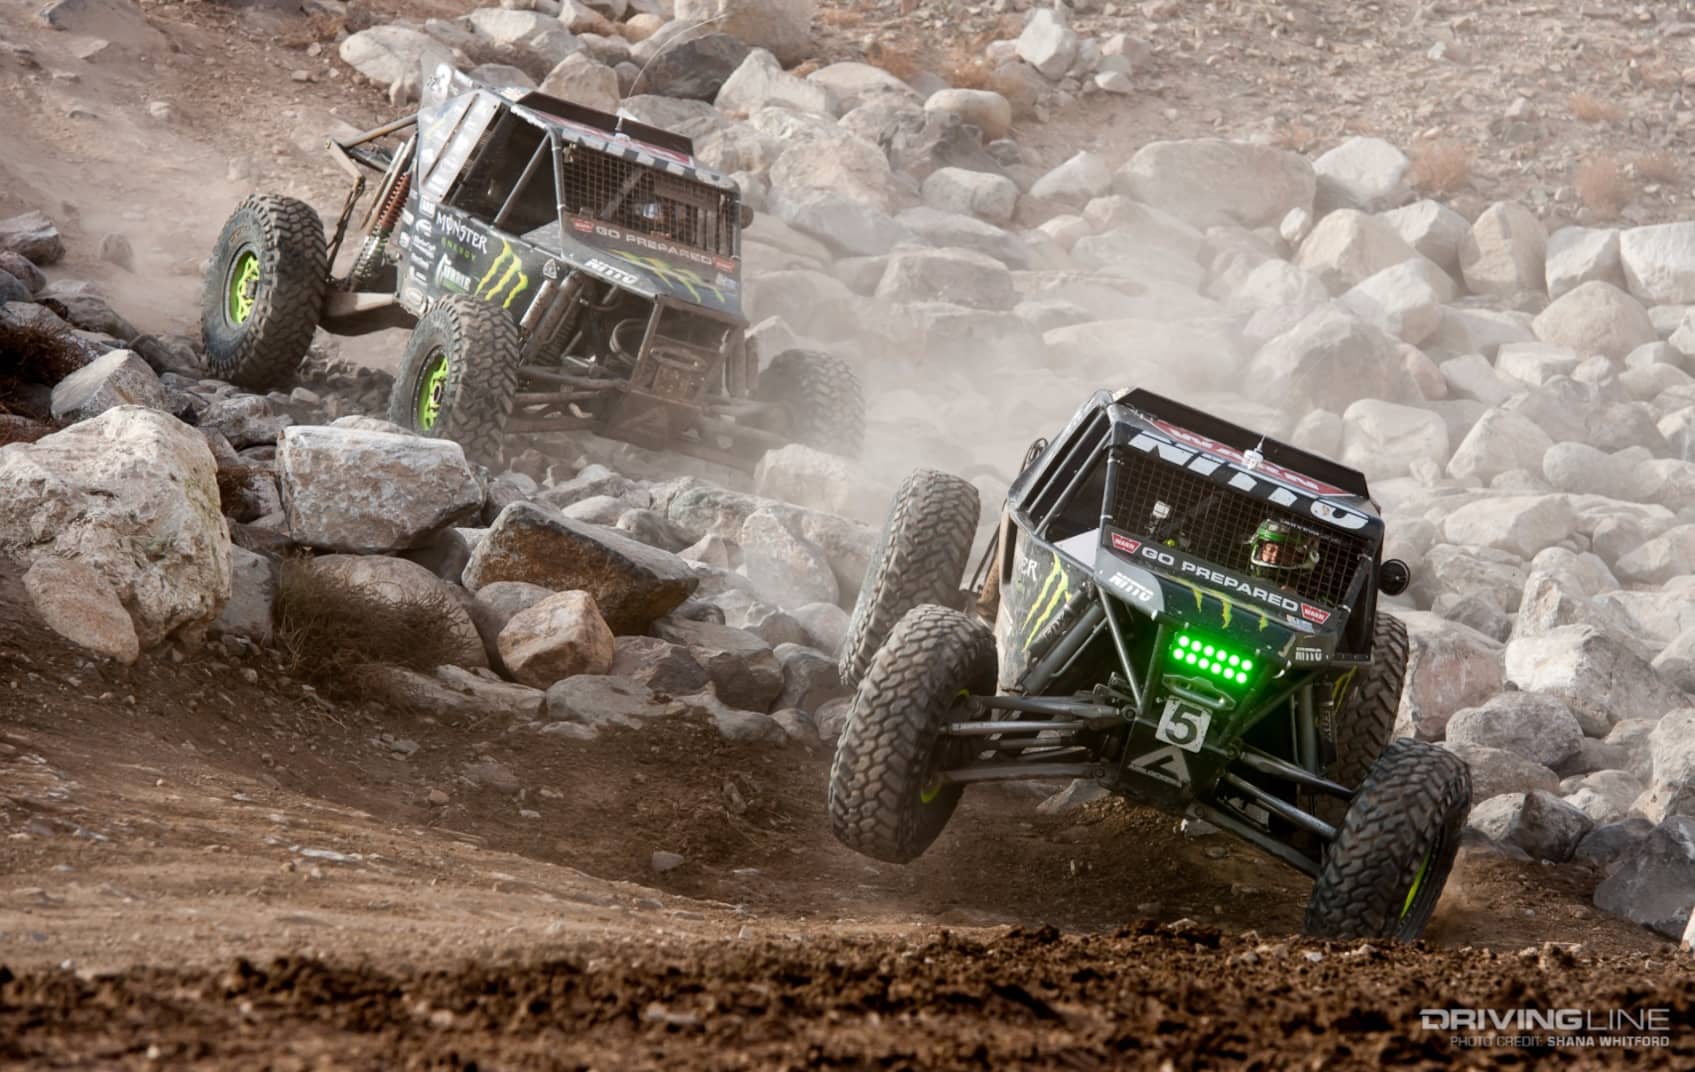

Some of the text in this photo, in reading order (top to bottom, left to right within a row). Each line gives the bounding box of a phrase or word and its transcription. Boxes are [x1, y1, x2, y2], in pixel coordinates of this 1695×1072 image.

[436, 211, 487, 254] MONSTER
[596, 225, 621, 239] GO
[625, 232, 712, 265] PREPARED
[585, 258, 639, 285] NITTO
[1141, 546, 1175, 566] GO
[1181, 560, 1299, 612] PREPARED
[1165, 703, 1203, 746] 5
